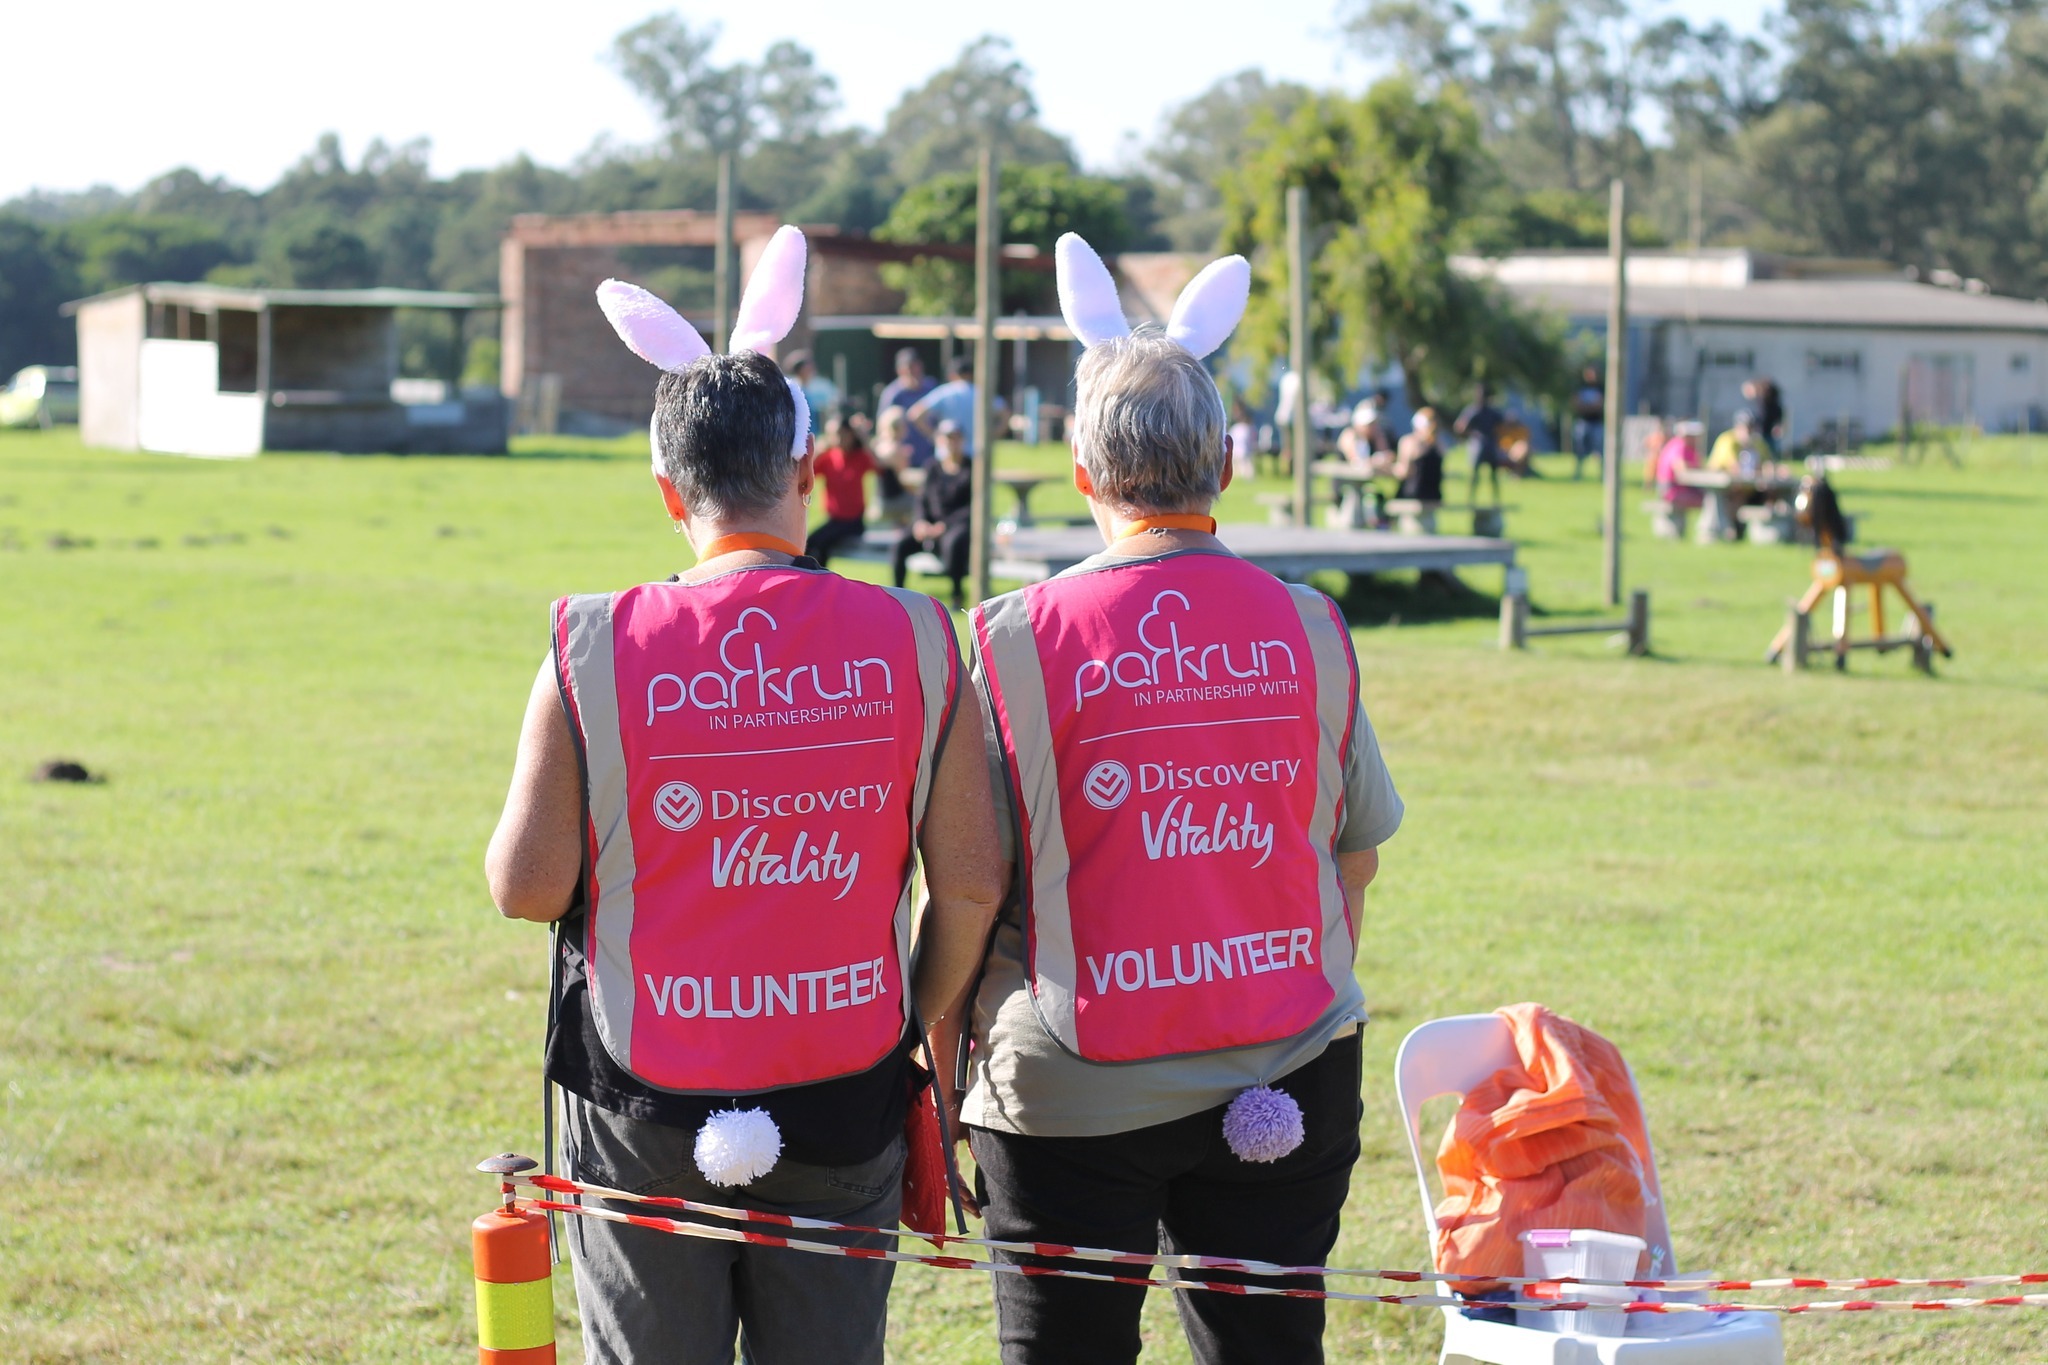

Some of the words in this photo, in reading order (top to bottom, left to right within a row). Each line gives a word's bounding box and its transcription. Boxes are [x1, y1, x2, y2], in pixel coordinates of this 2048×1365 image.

[647, 607, 893, 726] parkrun
[1075, 589, 1297, 713] parkrun
[709, 715, 727, 730] IN
[733, 705, 848, 729] PARTNERSHIP
[852, 700, 894, 718] WITH
[1134, 692, 1151, 707] IN
[1156, 683, 1256, 704] PARTNERSHIP
[1260, 680, 1299, 695] WITH
[711, 782, 893, 820] Discovery
[1138, 758, 1301, 794] Discovery
[711, 824, 860, 901] Vitality
[1141, 795, 1274, 869] Vitality
[644, 955, 887, 1019] VOLUNTEER
[1085, 927, 1315, 995] VOLUNTEER
